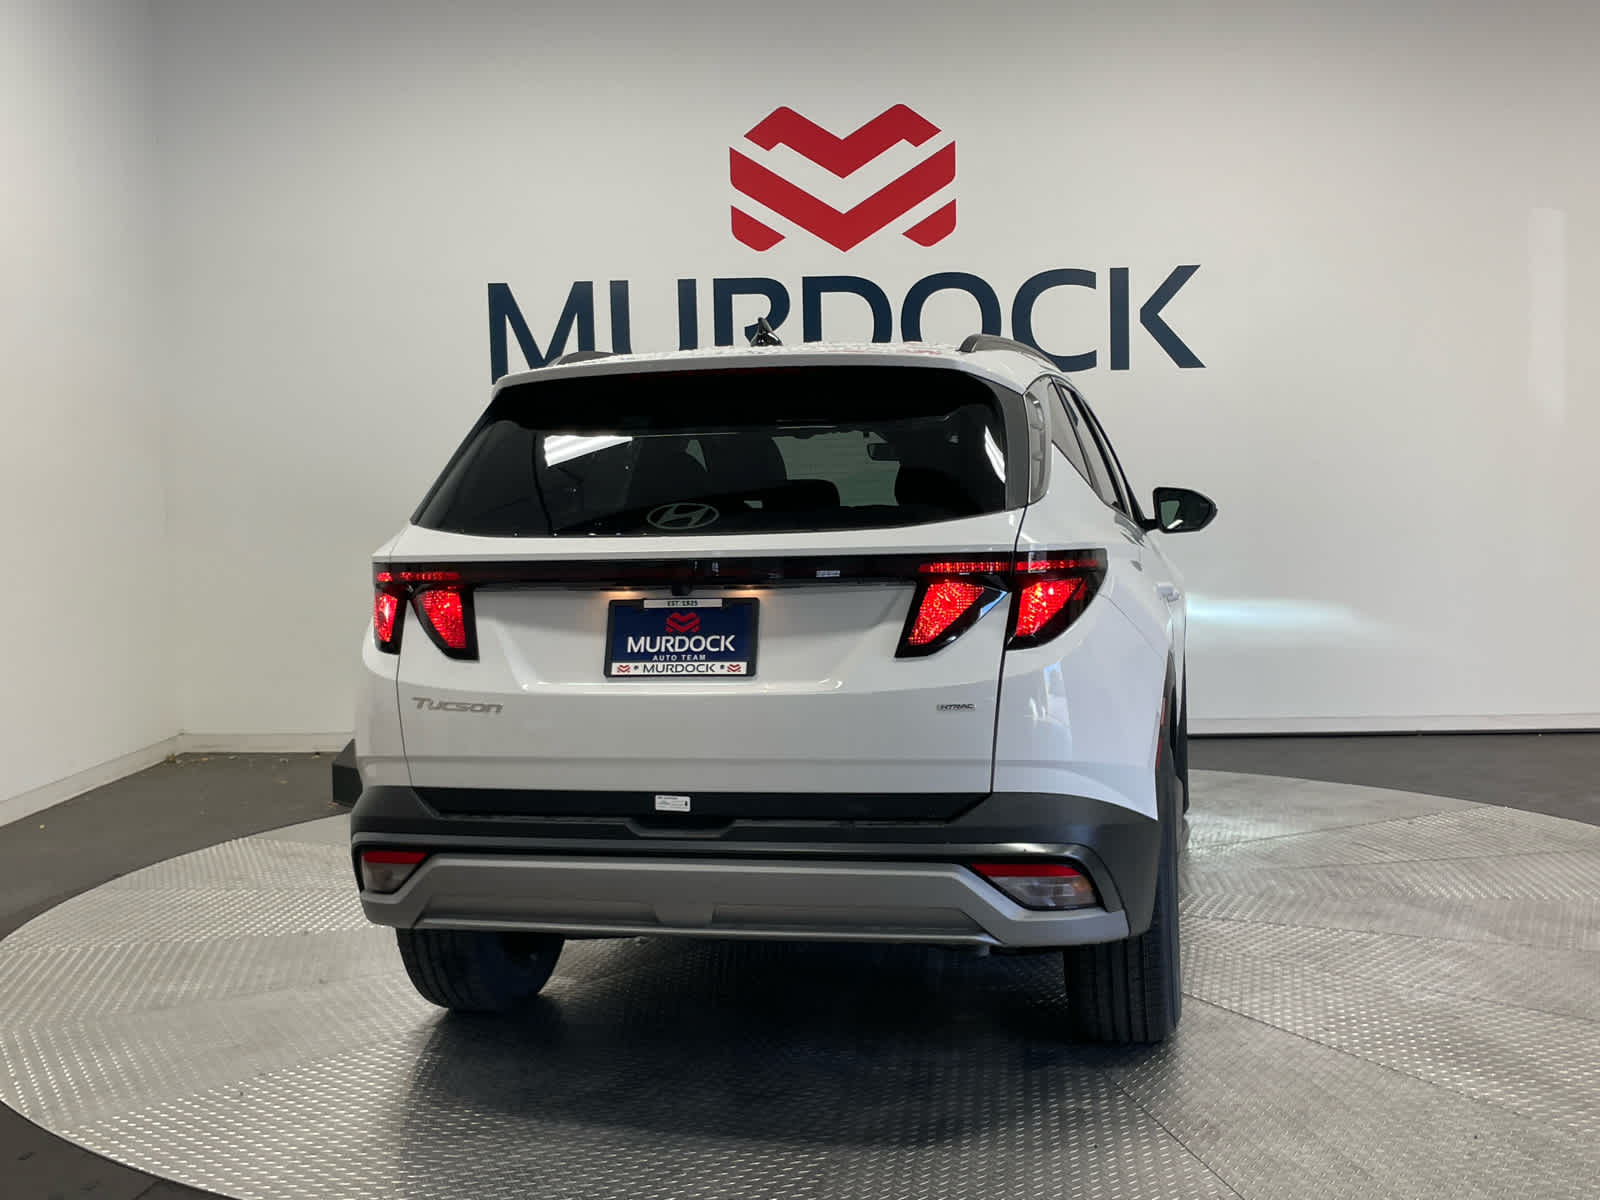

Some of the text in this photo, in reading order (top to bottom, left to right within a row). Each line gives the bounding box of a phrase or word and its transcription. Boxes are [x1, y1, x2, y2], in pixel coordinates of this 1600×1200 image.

[487, 264, 1206, 385] MURDOCK
[626, 634, 736, 653] MURDOCK
[652, 654, 678, 662] AUTO
[642, 663, 717, 674] MURDOCK
